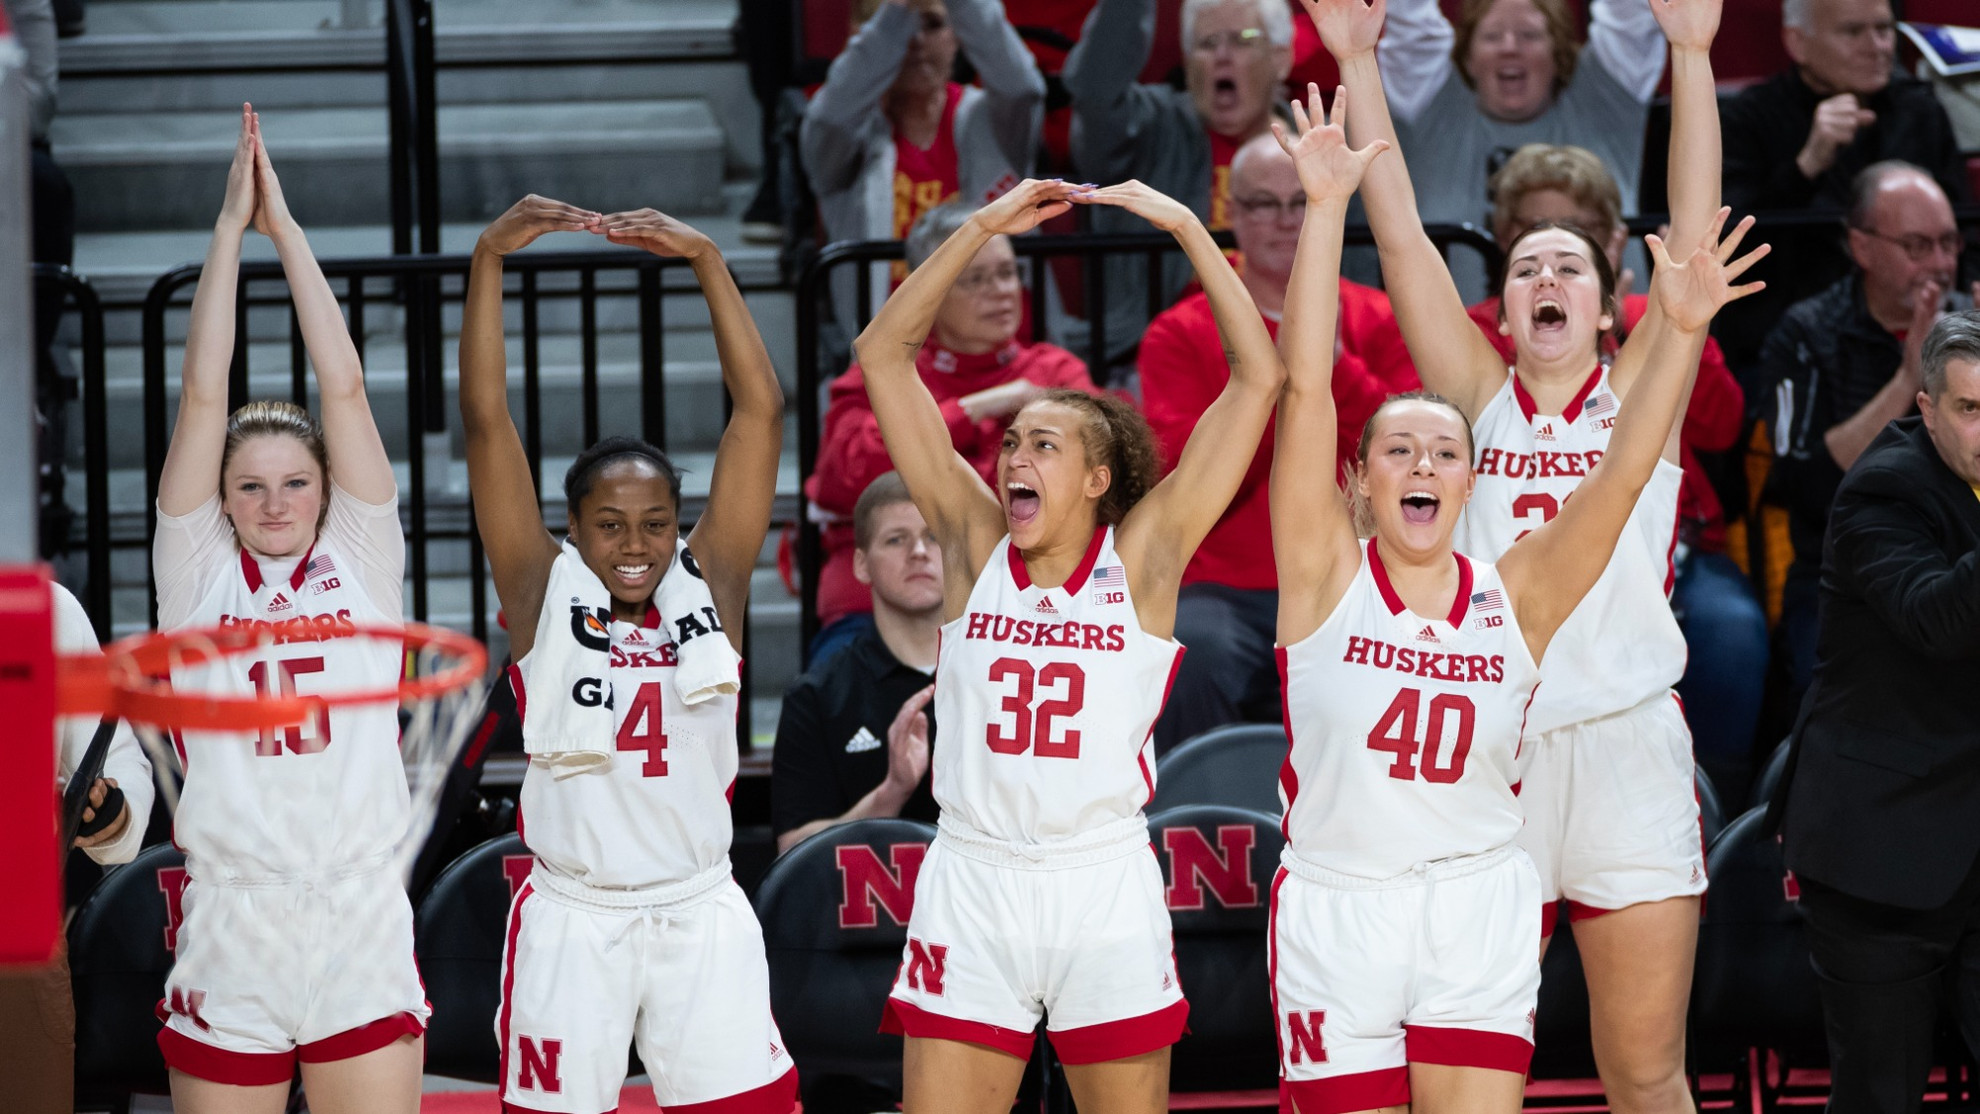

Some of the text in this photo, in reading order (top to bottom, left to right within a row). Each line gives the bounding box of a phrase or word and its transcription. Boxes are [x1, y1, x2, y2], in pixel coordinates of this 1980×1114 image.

[1512, 491, 1574, 542] 2
[220, 609, 356, 645] HSKERS
[267, 602, 293, 612] adidas
[966, 612, 1125, 652] HUSKERS
[1343, 635, 1504, 683] HUSKERS
[1416, 635, 1441, 643] adidas
[248, 656, 331, 757] 15
[616, 681, 668, 778] 4
[986, 657, 1085, 759] 32
[1367, 687, 1476, 784] 40
[836, 843, 927, 928] N
[1163, 825, 1258, 910] N
[906, 937, 949, 998] N
[518, 1034, 563, 1094] N
[1287, 1009, 1330, 1066] N
